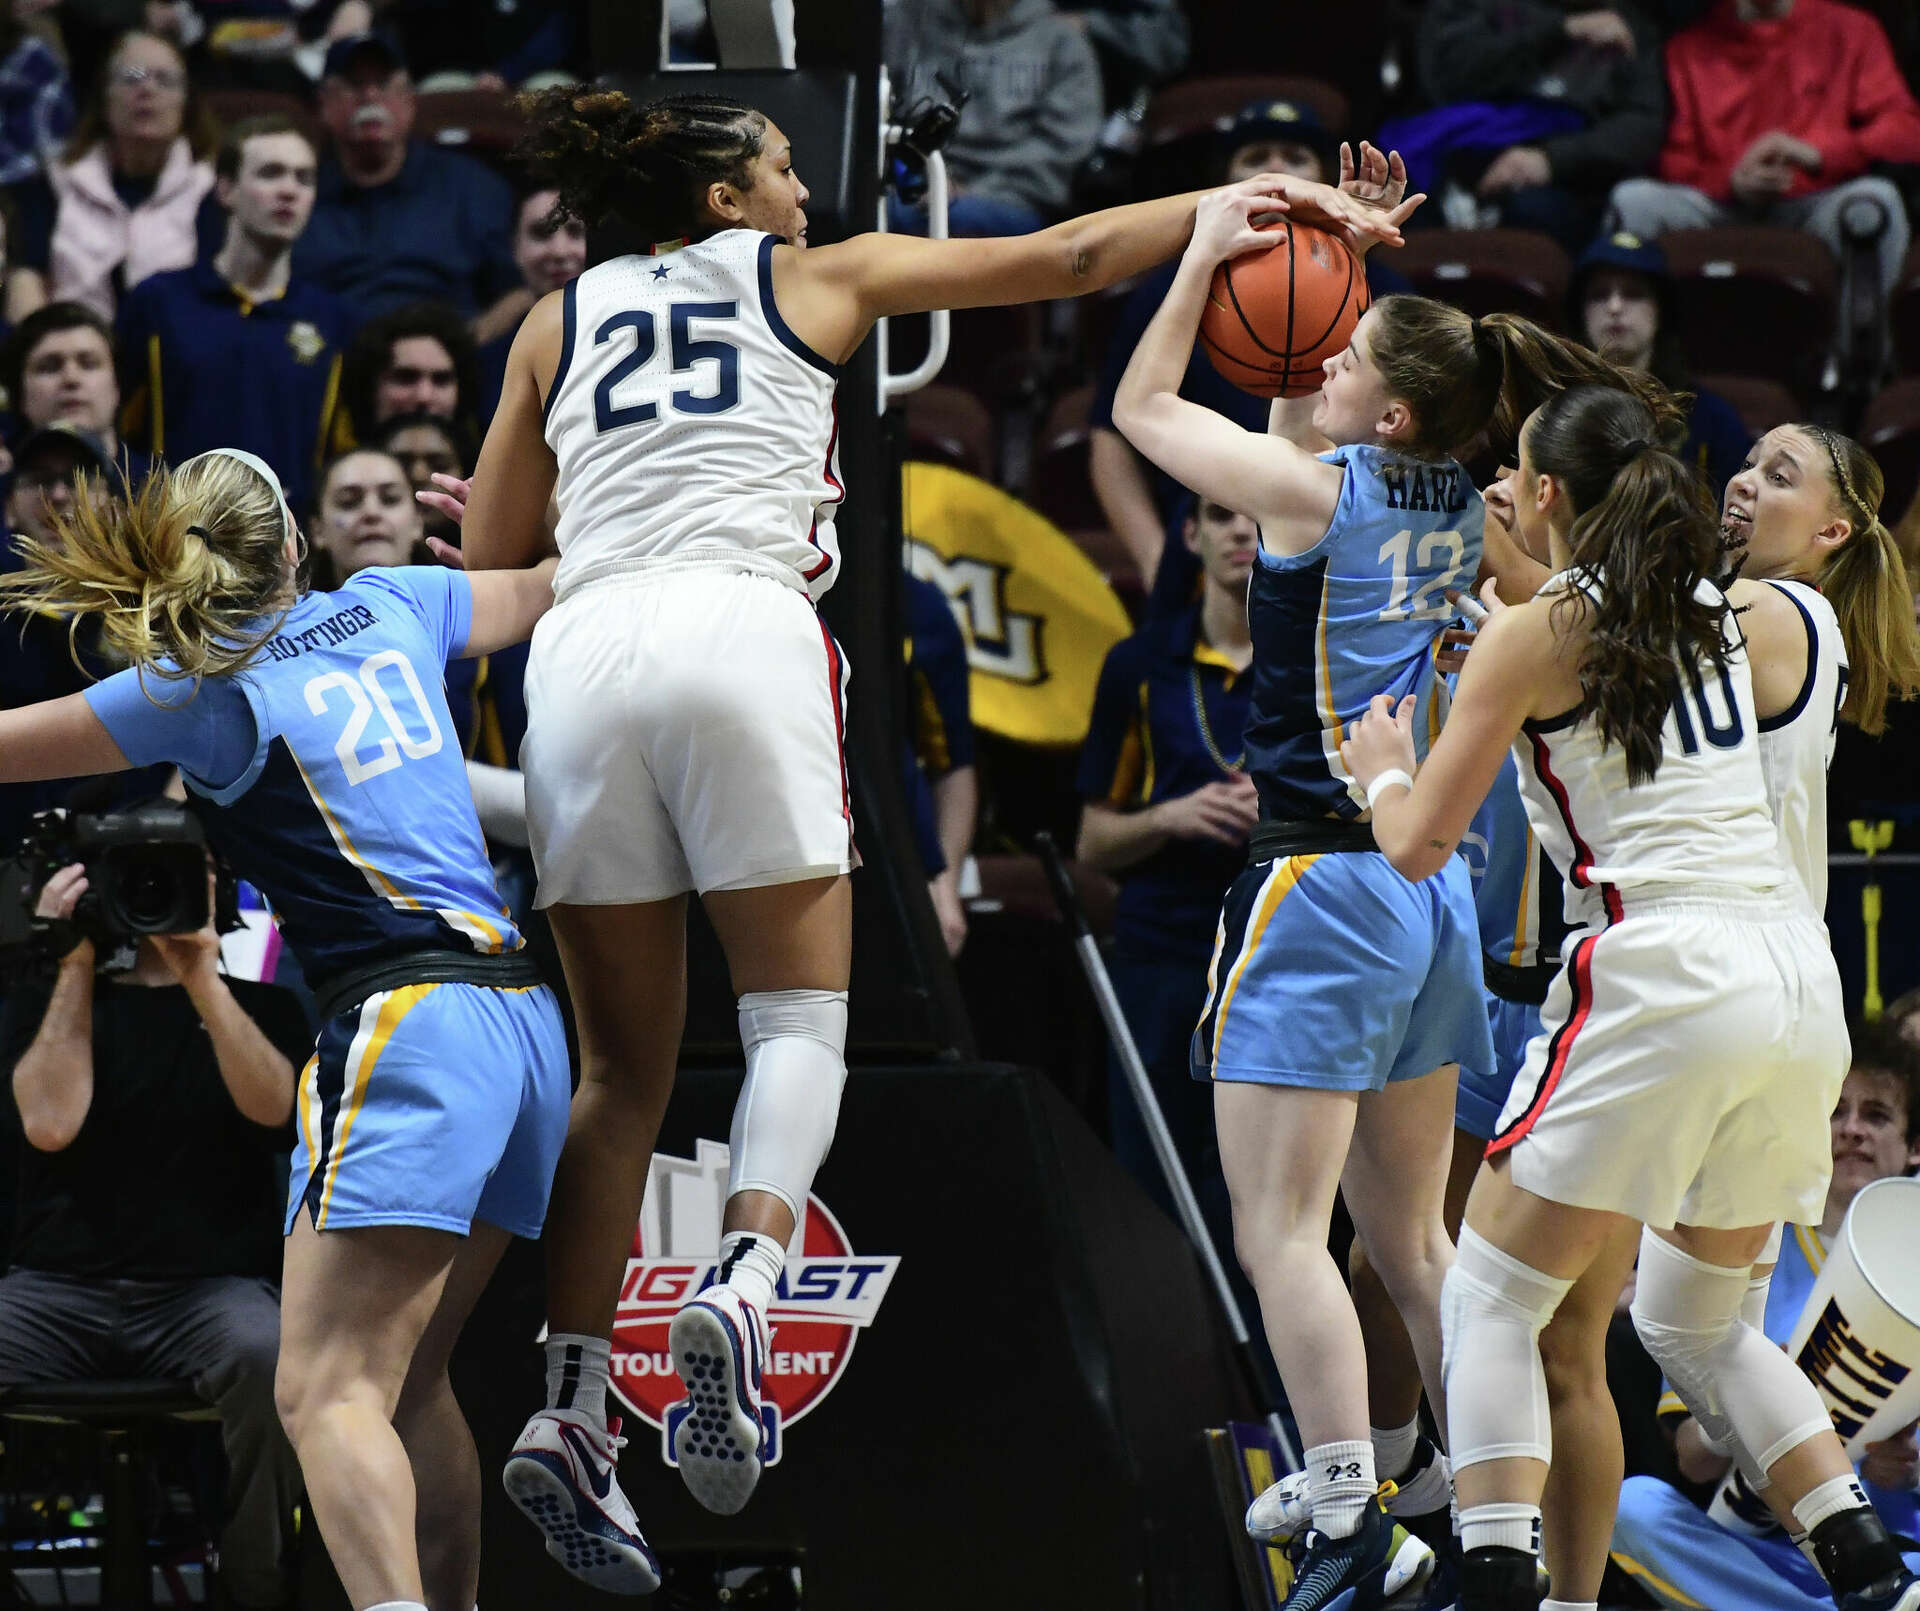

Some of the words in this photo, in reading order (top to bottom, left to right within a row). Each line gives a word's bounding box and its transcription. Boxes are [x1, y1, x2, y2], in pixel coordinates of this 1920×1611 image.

[592, 299, 741, 436] 25
[1382, 463, 1468, 514] HARE
[1378, 529, 1465, 622] 12
[303, 649, 443, 786] 20
[619, 1265, 697, 1301] IG
[610, 1352, 834, 1377] TOUENT
